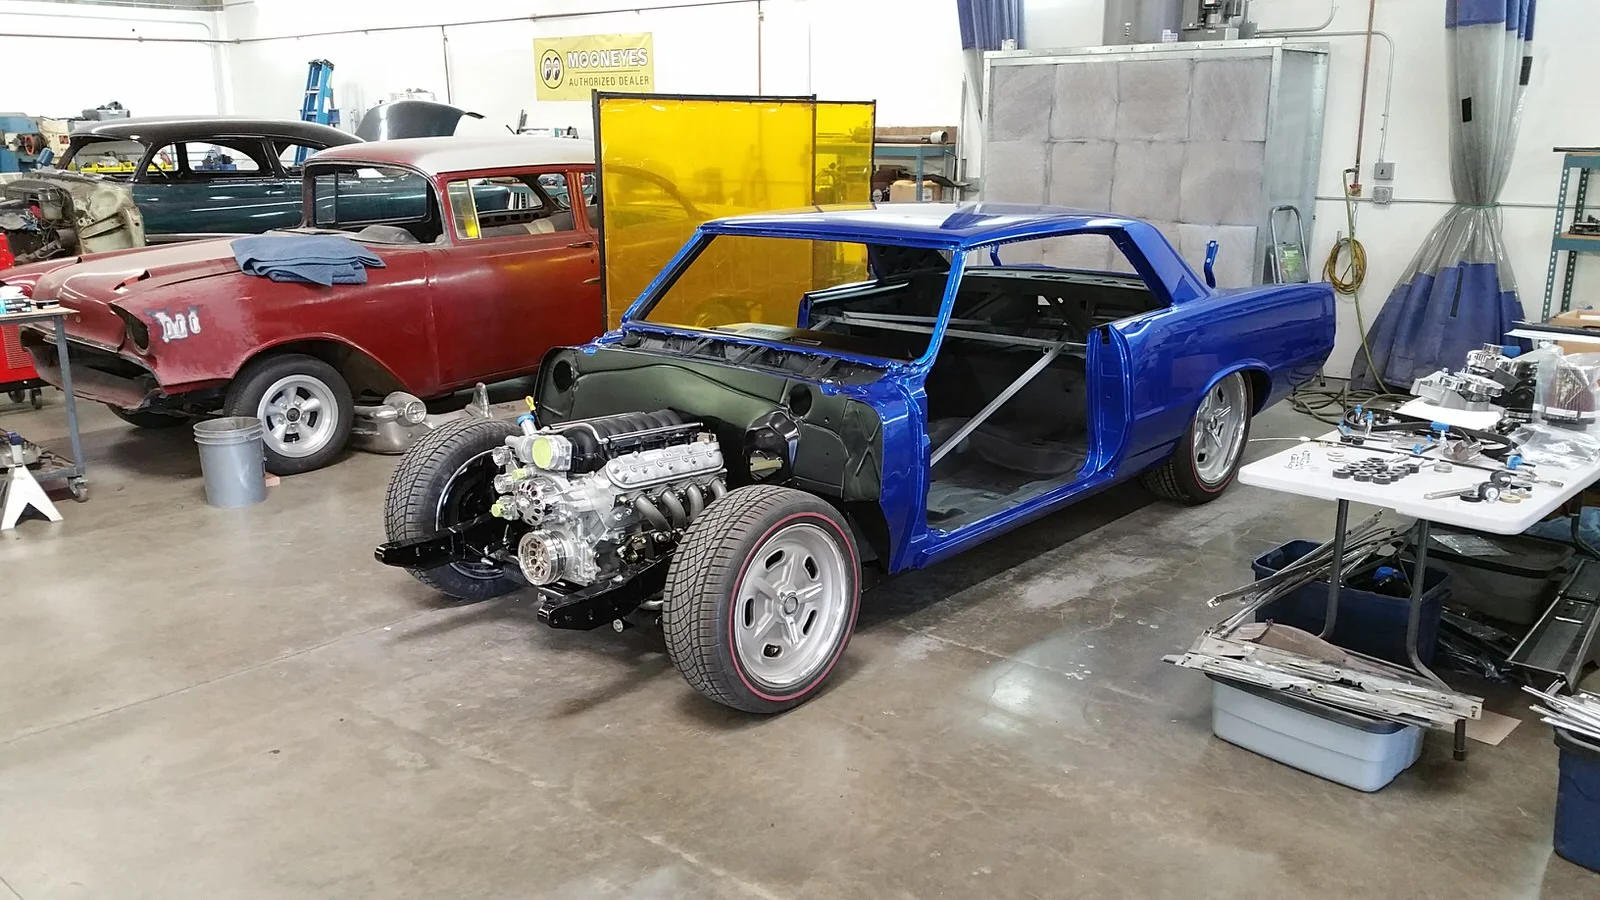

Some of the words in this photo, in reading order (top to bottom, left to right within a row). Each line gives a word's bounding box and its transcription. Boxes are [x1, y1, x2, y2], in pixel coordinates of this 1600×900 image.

[567, 48, 648, 68] MOONEYES
[569, 77, 615, 86] AUTHORIZED
[619, 75, 649, 85] DEALER
